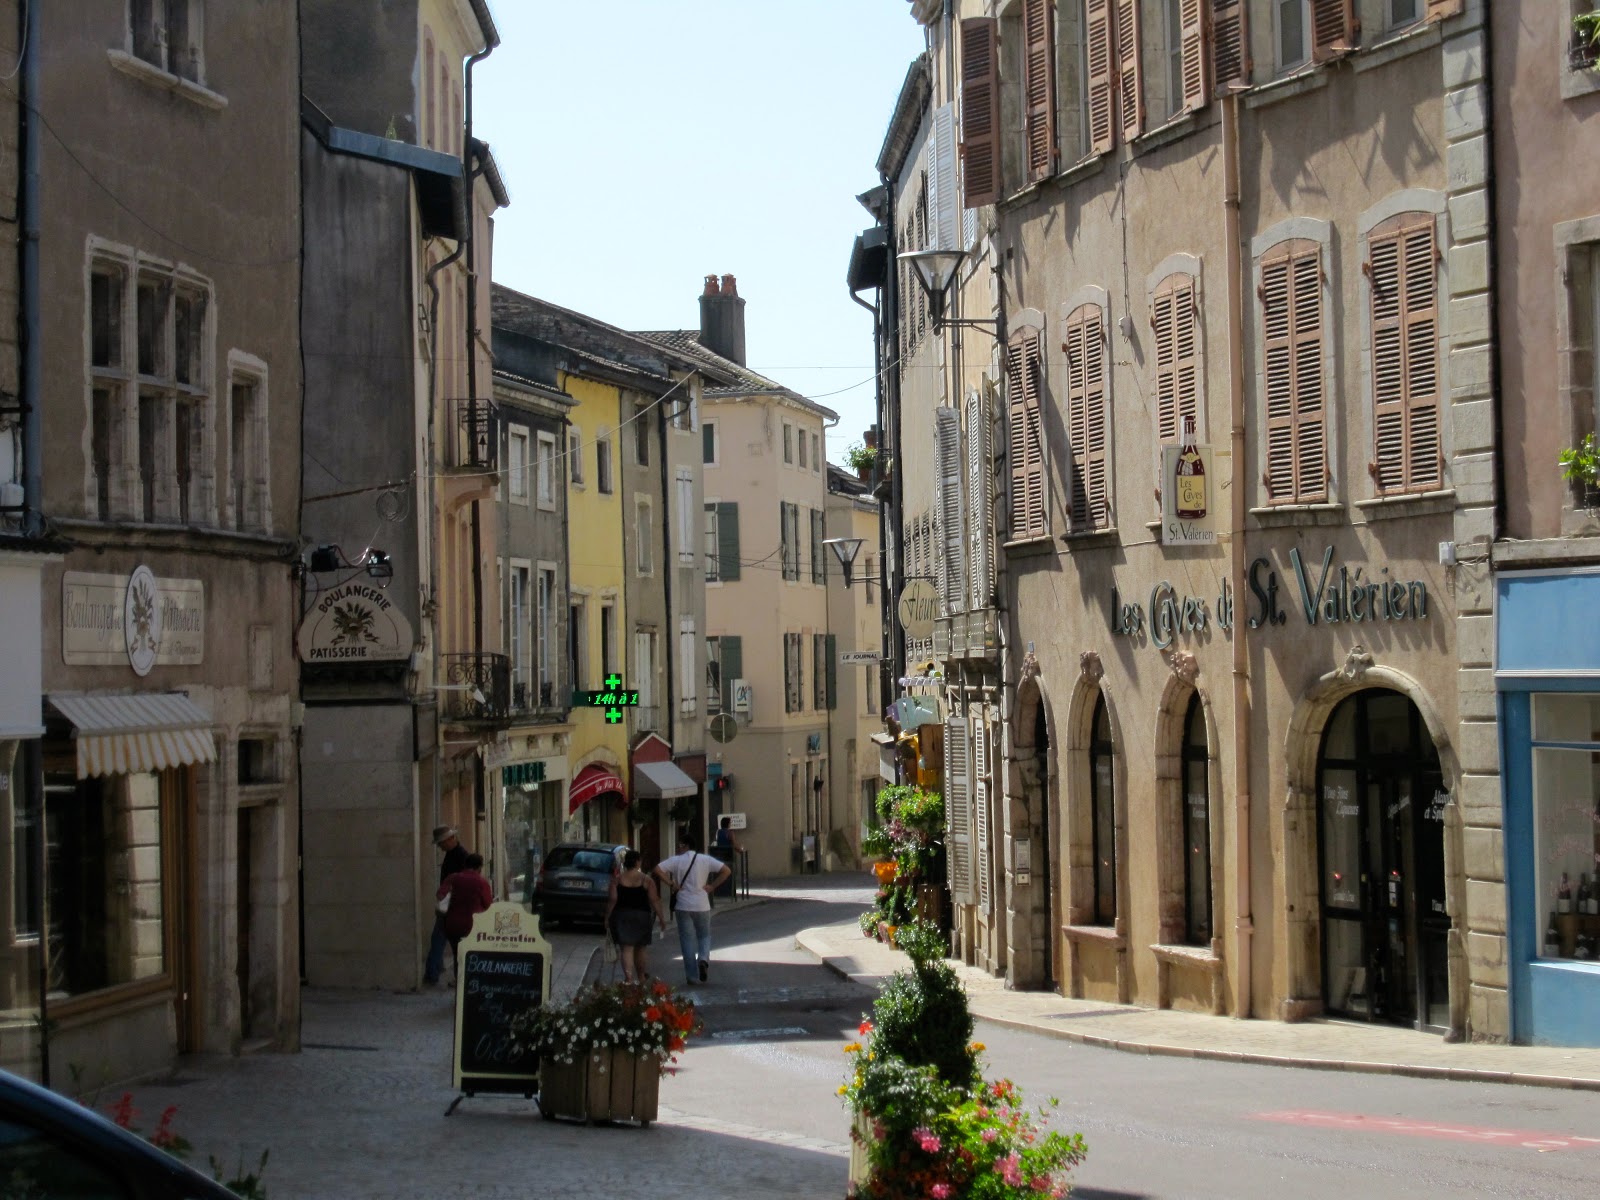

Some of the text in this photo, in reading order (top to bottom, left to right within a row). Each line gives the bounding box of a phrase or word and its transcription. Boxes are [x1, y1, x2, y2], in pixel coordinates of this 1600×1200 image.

[1179, 477, 1192, 488] Les
[1183, 488, 1203, 503] Caves
[1193, 501, 1202, 509] de
[1169, 522, 1214, 541] St. Valérien
[318, 585, 392, 614] BOULANGERIE
[1111, 586, 1141, 636] Les
[1148, 579, 1206, 650] Caves
[1248, 557, 1286, 630] St.
[1289, 545, 1428, 625] Valérien
[65, 587, 122, 642] Boulangerie
[310, 646, 367, 659] PATISSERIE
[593, 693, 616, 705] 14h
[618, 692, 628, 705] à
[467, 954, 534, 976] BOULANGERIE
